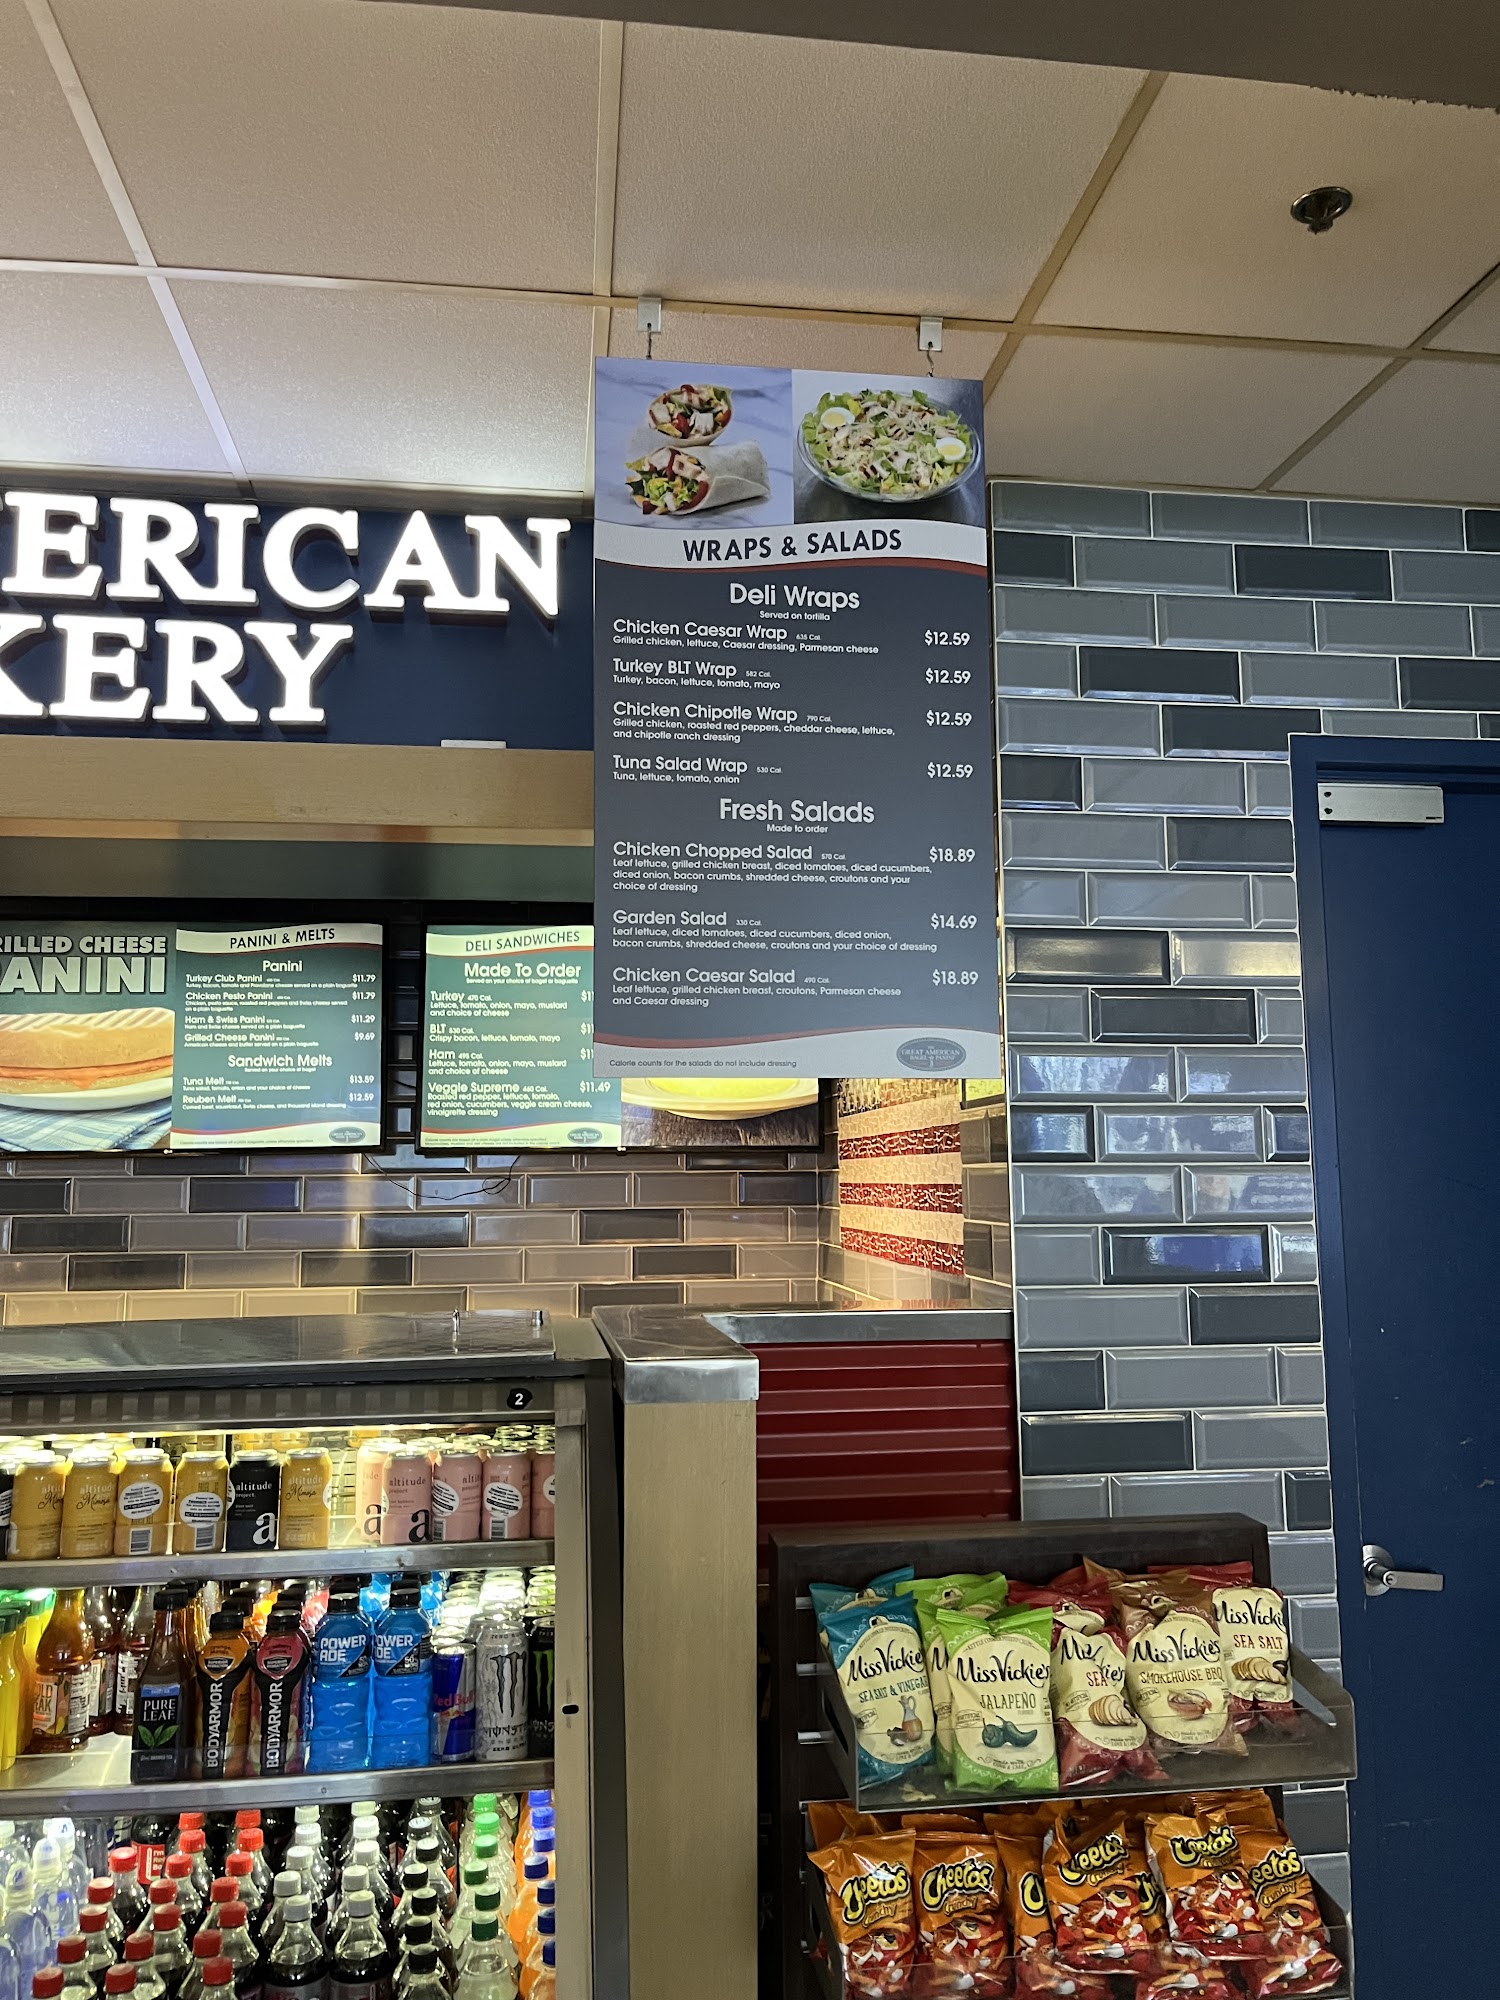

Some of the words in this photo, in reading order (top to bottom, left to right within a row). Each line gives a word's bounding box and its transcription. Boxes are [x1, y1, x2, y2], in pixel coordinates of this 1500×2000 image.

[683, 537, 771, 561] WRAPS
[782, 536, 798, 556] &
[808, 529, 902, 554] SALADS
[730, 583, 776, 605] Deli
[784, 586, 860, 612] Wraps
[760, 611, 788, 619] Served
[804, 613, 830, 621] tortilla
[613, 619, 679, 635] Chicken
[685, 622, 742, 638] Caesar
[746, 625, 787, 642] Wrap
[925, 630, 970, 646] $12.59
[613, 636, 643, 644] Grilled
[646, 638, 684, 647] chicken,
[687, 639, 720, 648] lettuce,
[723, 641, 755, 649] Caesar
[758, 642, 797, 652] dressing,
[800, 643, 843, 652] Parmesan
[846, 645, 879, 653] cheese
[613, 658, 663, 676] Turkey
[668, 661, 691, 674] BLT
[696, 662, 737, 678] Wrap
[926, 668, 971, 684] $12.59
[613, 675, 643, 684] Turkey,
[646, 676, 678, 686] bacon,
[681, 678, 714, 687] lettuce,
[717, 679, 751, 688] tomato,
[613, 702, 679, 717] Chicken
[685, 704, 752, 721] Chipotle
[757, 707, 797, 723] Wrap
[927, 710, 972, 726] $12.59
[613, 718, 643, 727] Grilled
[646, 720, 685, 729] chicken,
[688, 722, 721, 730] roasted
[742, 724, 781, 732] peppers,
[784, 724, 822, 733] cheddar
[825, 726, 860, 735] cheese,
[862, 726, 895, 736] lettuce,
[613, 730, 631, 738] and
[634, 731, 671, 740] chipotle
[674, 732, 700, 740] ranch
[703, 733, 740, 743] dressing
[613, 755, 650, 769] Tuna
[656, 756, 701, 771] Salad
[706, 758, 748, 775] Wrap
[928, 762, 973, 778] $12.59
[613, 772, 637, 781] Tuna,
[640, 773, 673, 782] lettuce,
[677, 774, 711, 783] tomato,
[720, 798, 782, 820] Fresh
[791, 800, 874, 823] Salads
[767, 824, 792, 832] Made
[613, 842, 680, 857] Chicken
[686, 843, 762, 860] Chopped
[767, 845, 812, 859] Salad
[929, 846, 975, 863] $18.89
[613, 910, 675, 924] Garden
[681, 911, 726, 925] Salad
[931, 913, 977, 929] $14.69
[79, 937, 166, 953] CHEESE
[230, 934, 276, 949] PANINI
[282, 933, 290, 943] &
[295, 928, 335, 942] MELTS
[465, 940, 491, 952] DELI
[496, 931, 580, 950] SANDWICHES
[262, 960, 302, 972] Panini
[464, 963, 511, 977] Made
[515, 963, 532, 977] To
[536, 963, 581, 977] Order
[186, 974, 212, 983] Turkey
[215, 974, 234, 982] Club
[237, 974, 262, 982] Panini
[353, 974, 376, 983] $11.79
[613, 967, 680, 982] Chicken
[686, 968, 744, 982] Caesar
[749, 969, 795, 983] Salad
[932, 969, 978, 986] $18.89
[186, 992, 221, 1000] Chicken
[224, 992, 245, 1000] Pesto
[352, 992, 375, 1000] $11.79
[430, 991, 464, 1003] Turkey
[240, 1015, 265, 1023] Panini
[352, 1015, 375, 1023] $11.29
[184, 1033, 212, 1042] Grilled
[215, 1033, 247, 1042] Cheese
[250, 1033, 275, 1041] Panini
[355, 1032, 375, 1041] $9.69
[430, 1024, 446, 1033] BLT
[228, 1054, 293, 1067] Sandwich
[297, 1054, 332, 1066] Melts
[429, 1049, 455, 1060] Ham
[183, 1077, 203, 1085] Tuna
[205, 1076, 224, 1085] Melt
[349, 1075, 374, 1084] $13.59
[428, 1082, 467, 1094] Veggie
[471, 1082, 519, 1094] Supreme
[579, 1081, 611, 1093] $11.49
[183, 1095, 215, 1104] Reuben
[217, 1095, 236, 1103] Melt
[349, 1093, 374, 1102] $12.59
[514, 1393, 523, 1406] 2
[235, 1482, 273, 1492] altitude
[389, 1477, 426, 1487] altitude
[253, 1512, 275, 1545] a
[409, 1509, 431, 1542] a
[320, 1635, 367, 1650] POWER
[1132, 1642, 1175, 1664] Miss
[1167, 1629, 1220, 1663] Vickie's
[1233, 1634, 1254, 1649] SEA
[1259, 1635, 1283, 1650] SALT
[319, 1649, 346, 1662] ADE
[847, 1655, 882, 1686] Miss
[957, 1657, 997, 1682] Miss
[990, 1650, 1050, 1688] Vickie's
[1140, 1668, 1203, 1685] SMOKEHOUSE
[1204, 1666, 1224, 1683] BBQ
[859, 1689, 875, 1703] SEA
[875, 1687, 887, 1700] SALT
[890, 1686, 898, 1696] &
[144, 1699, 176, 1710] PURE
[143, 1709, 175, 1721] LEAF
[207, 1682, 223, 1767] BODYARMOR
[266, 1682, 283, 1768] BODYARMOR
[1170, 1827, 1236, 1865] Ceetos
[1058, 1834, 1127, 1885] Ceetos
[1251, 1850, 1303, 1883] eetos
[922, 1858, 994, 1908] Cheetos
[840, 1863, 910, 1922] Cheetos
[1260, 1881, 1297, 1907] Crunchy
